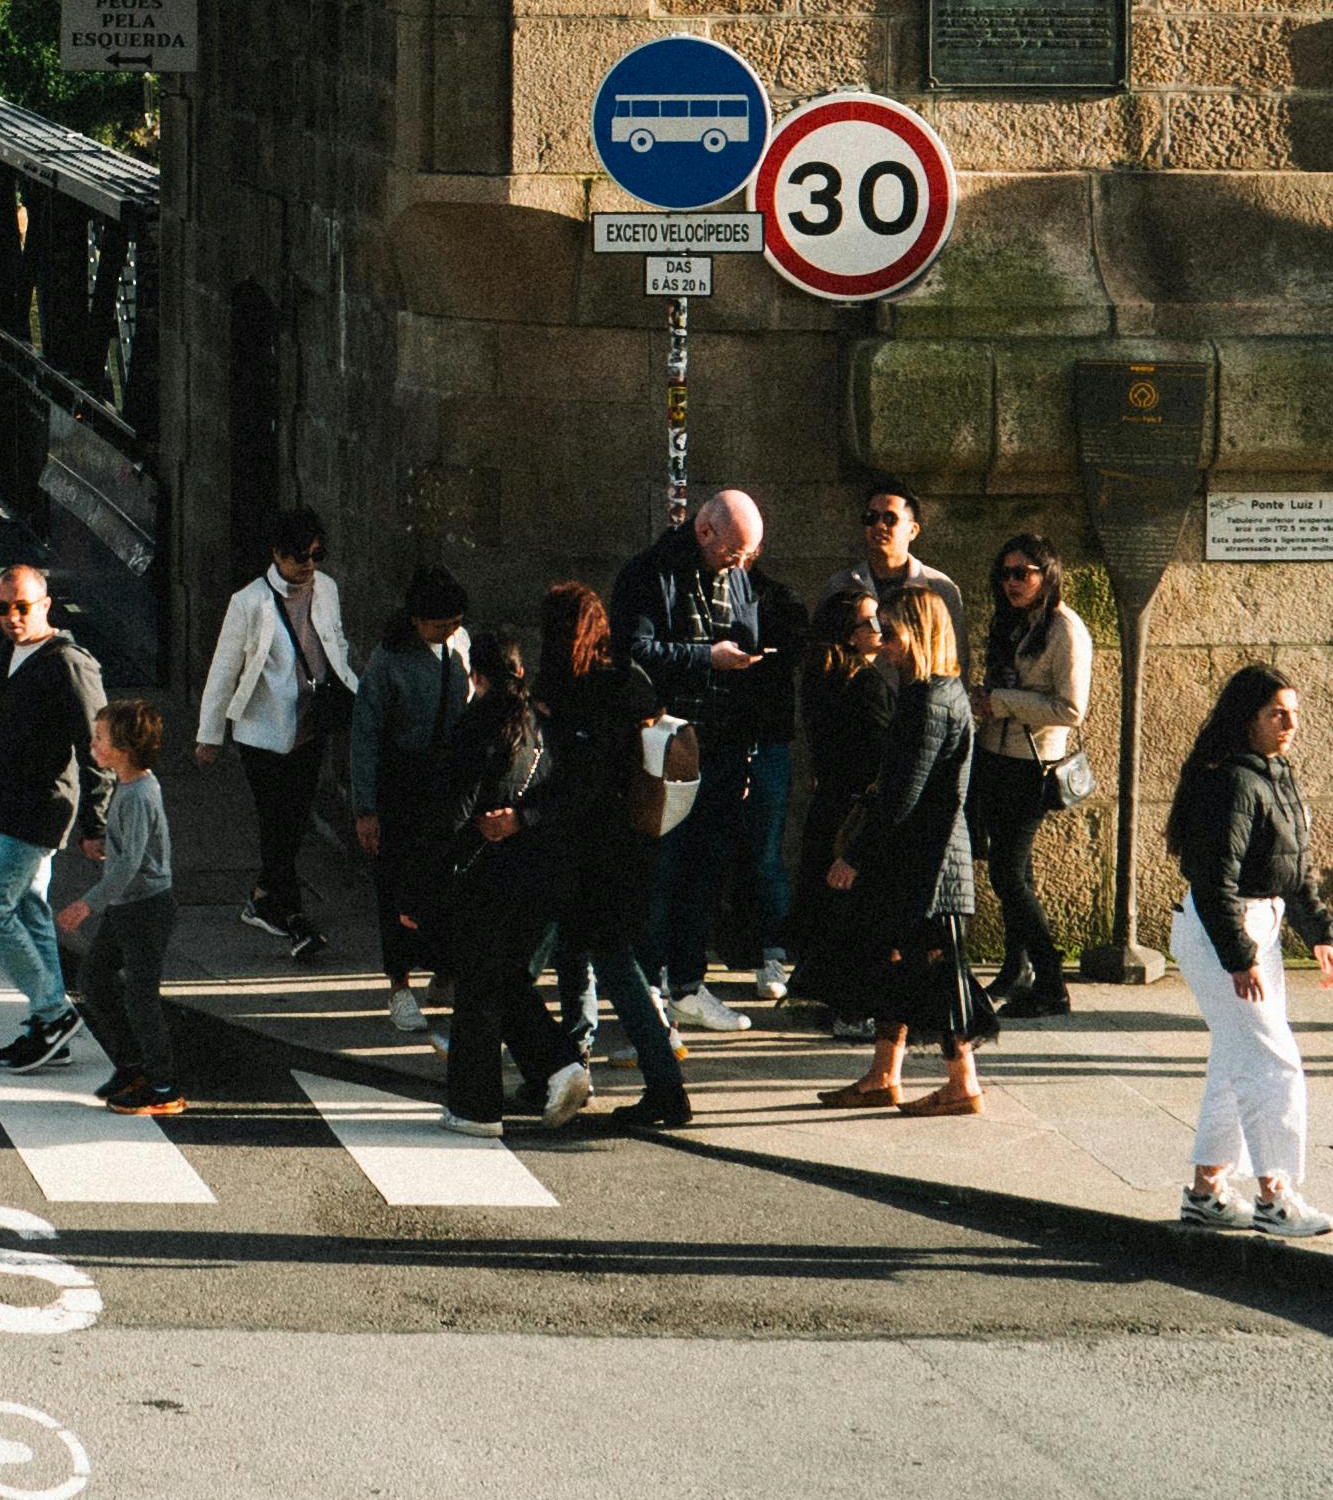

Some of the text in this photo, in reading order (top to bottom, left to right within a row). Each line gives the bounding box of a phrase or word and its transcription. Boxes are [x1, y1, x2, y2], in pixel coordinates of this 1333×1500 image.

[101, 13, 156, 29] PELA
[71, 32, 186, 50] ESQUERDA
[787, 160, 919, 236] 30
[606, 218, 750, 243] EXCETO VELOCÍPEDES
[666, 260, 692, 273] DAS
[651, 280, 659, 291] 6
[682, 280, 696, 291] 20
[698, 279, 707, 291] h
[1251, 499, 1285, 510] Ponte
[1290, 499, 1314, 510] Luiz
